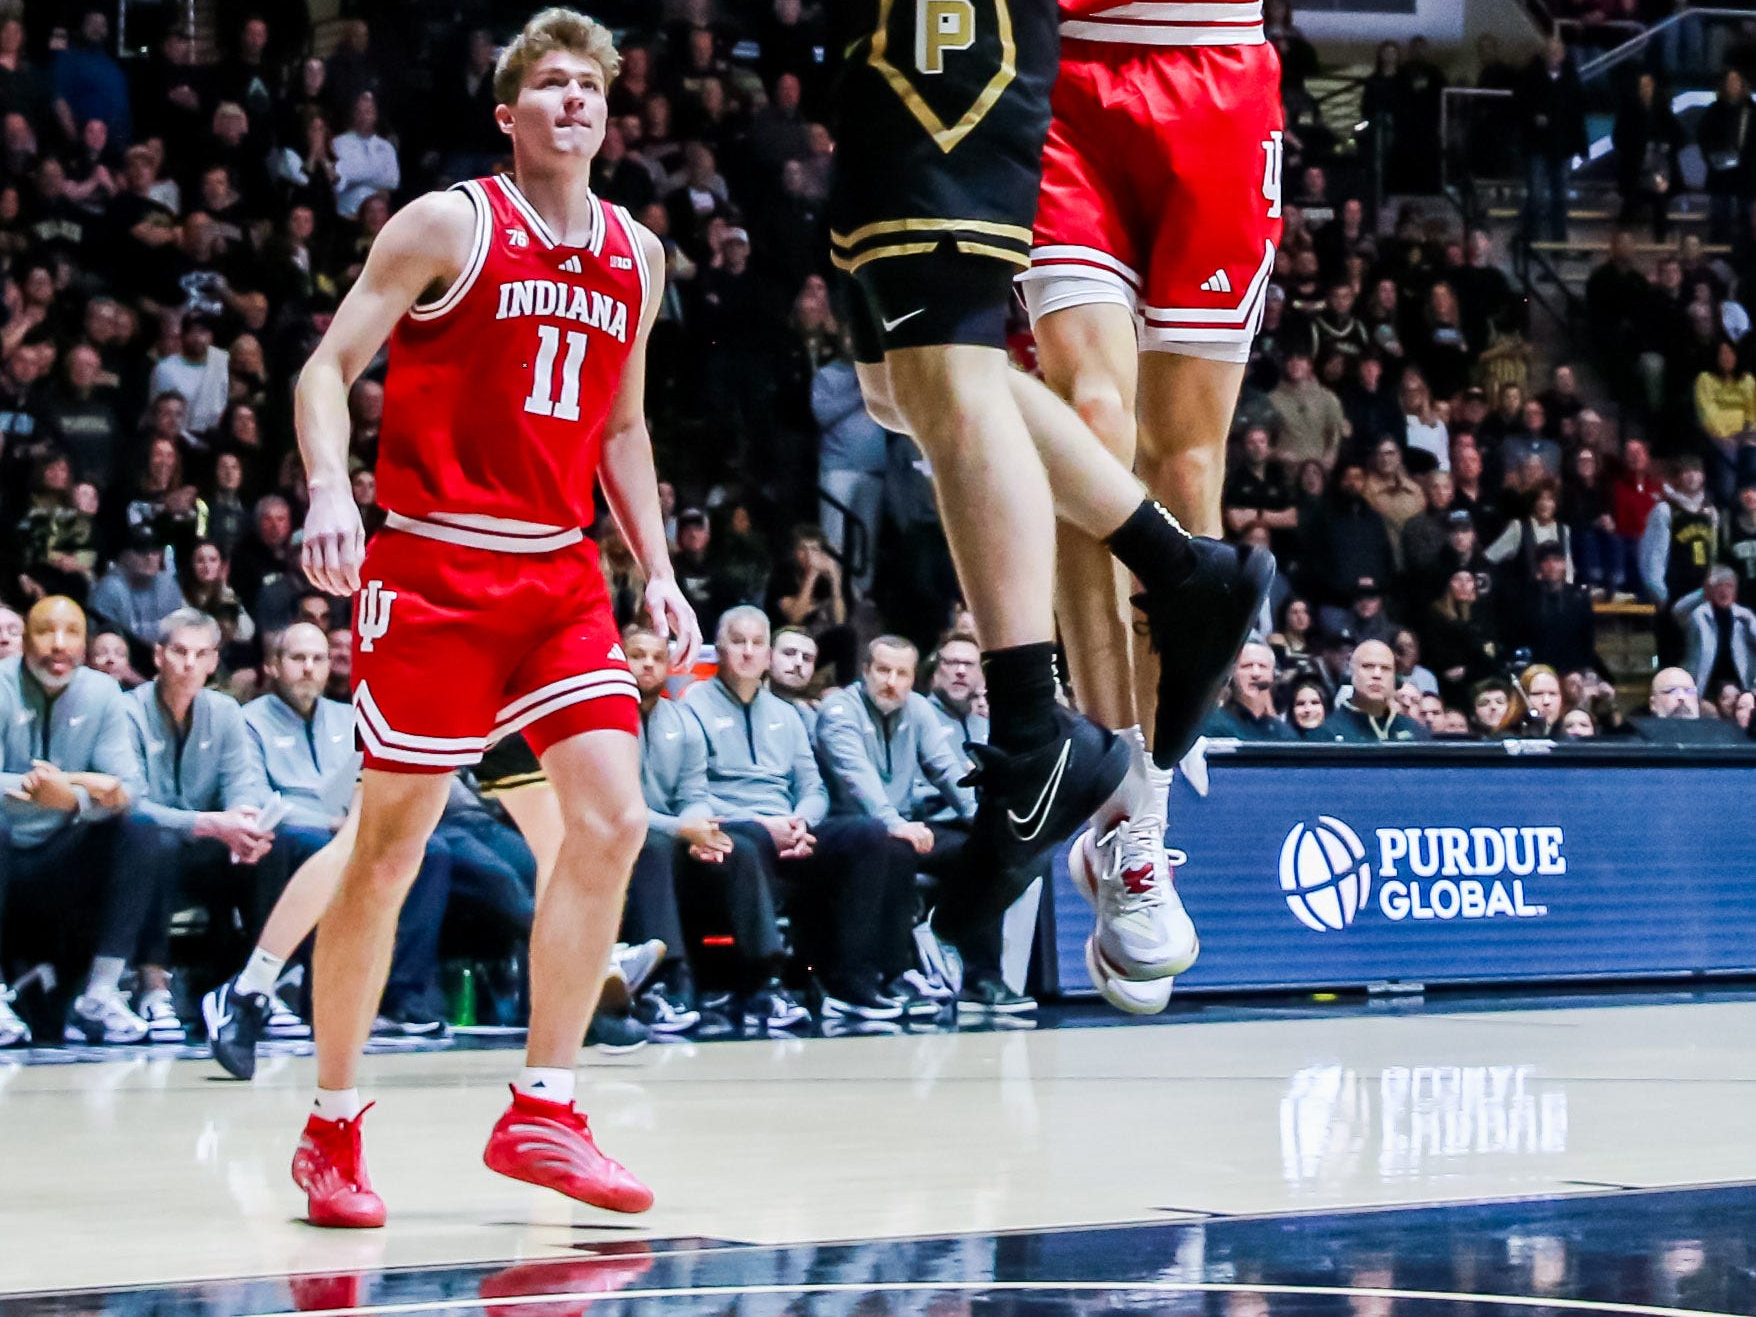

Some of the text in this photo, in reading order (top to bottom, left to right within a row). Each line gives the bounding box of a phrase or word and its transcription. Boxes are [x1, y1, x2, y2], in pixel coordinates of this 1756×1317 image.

[495, 279, 628, 344] INDIANA
[523, 324, 588, 422] 11
[1375, 826, 1567, 878] PURDUE
[1378, 878, 1538, 921] GLOBAL
